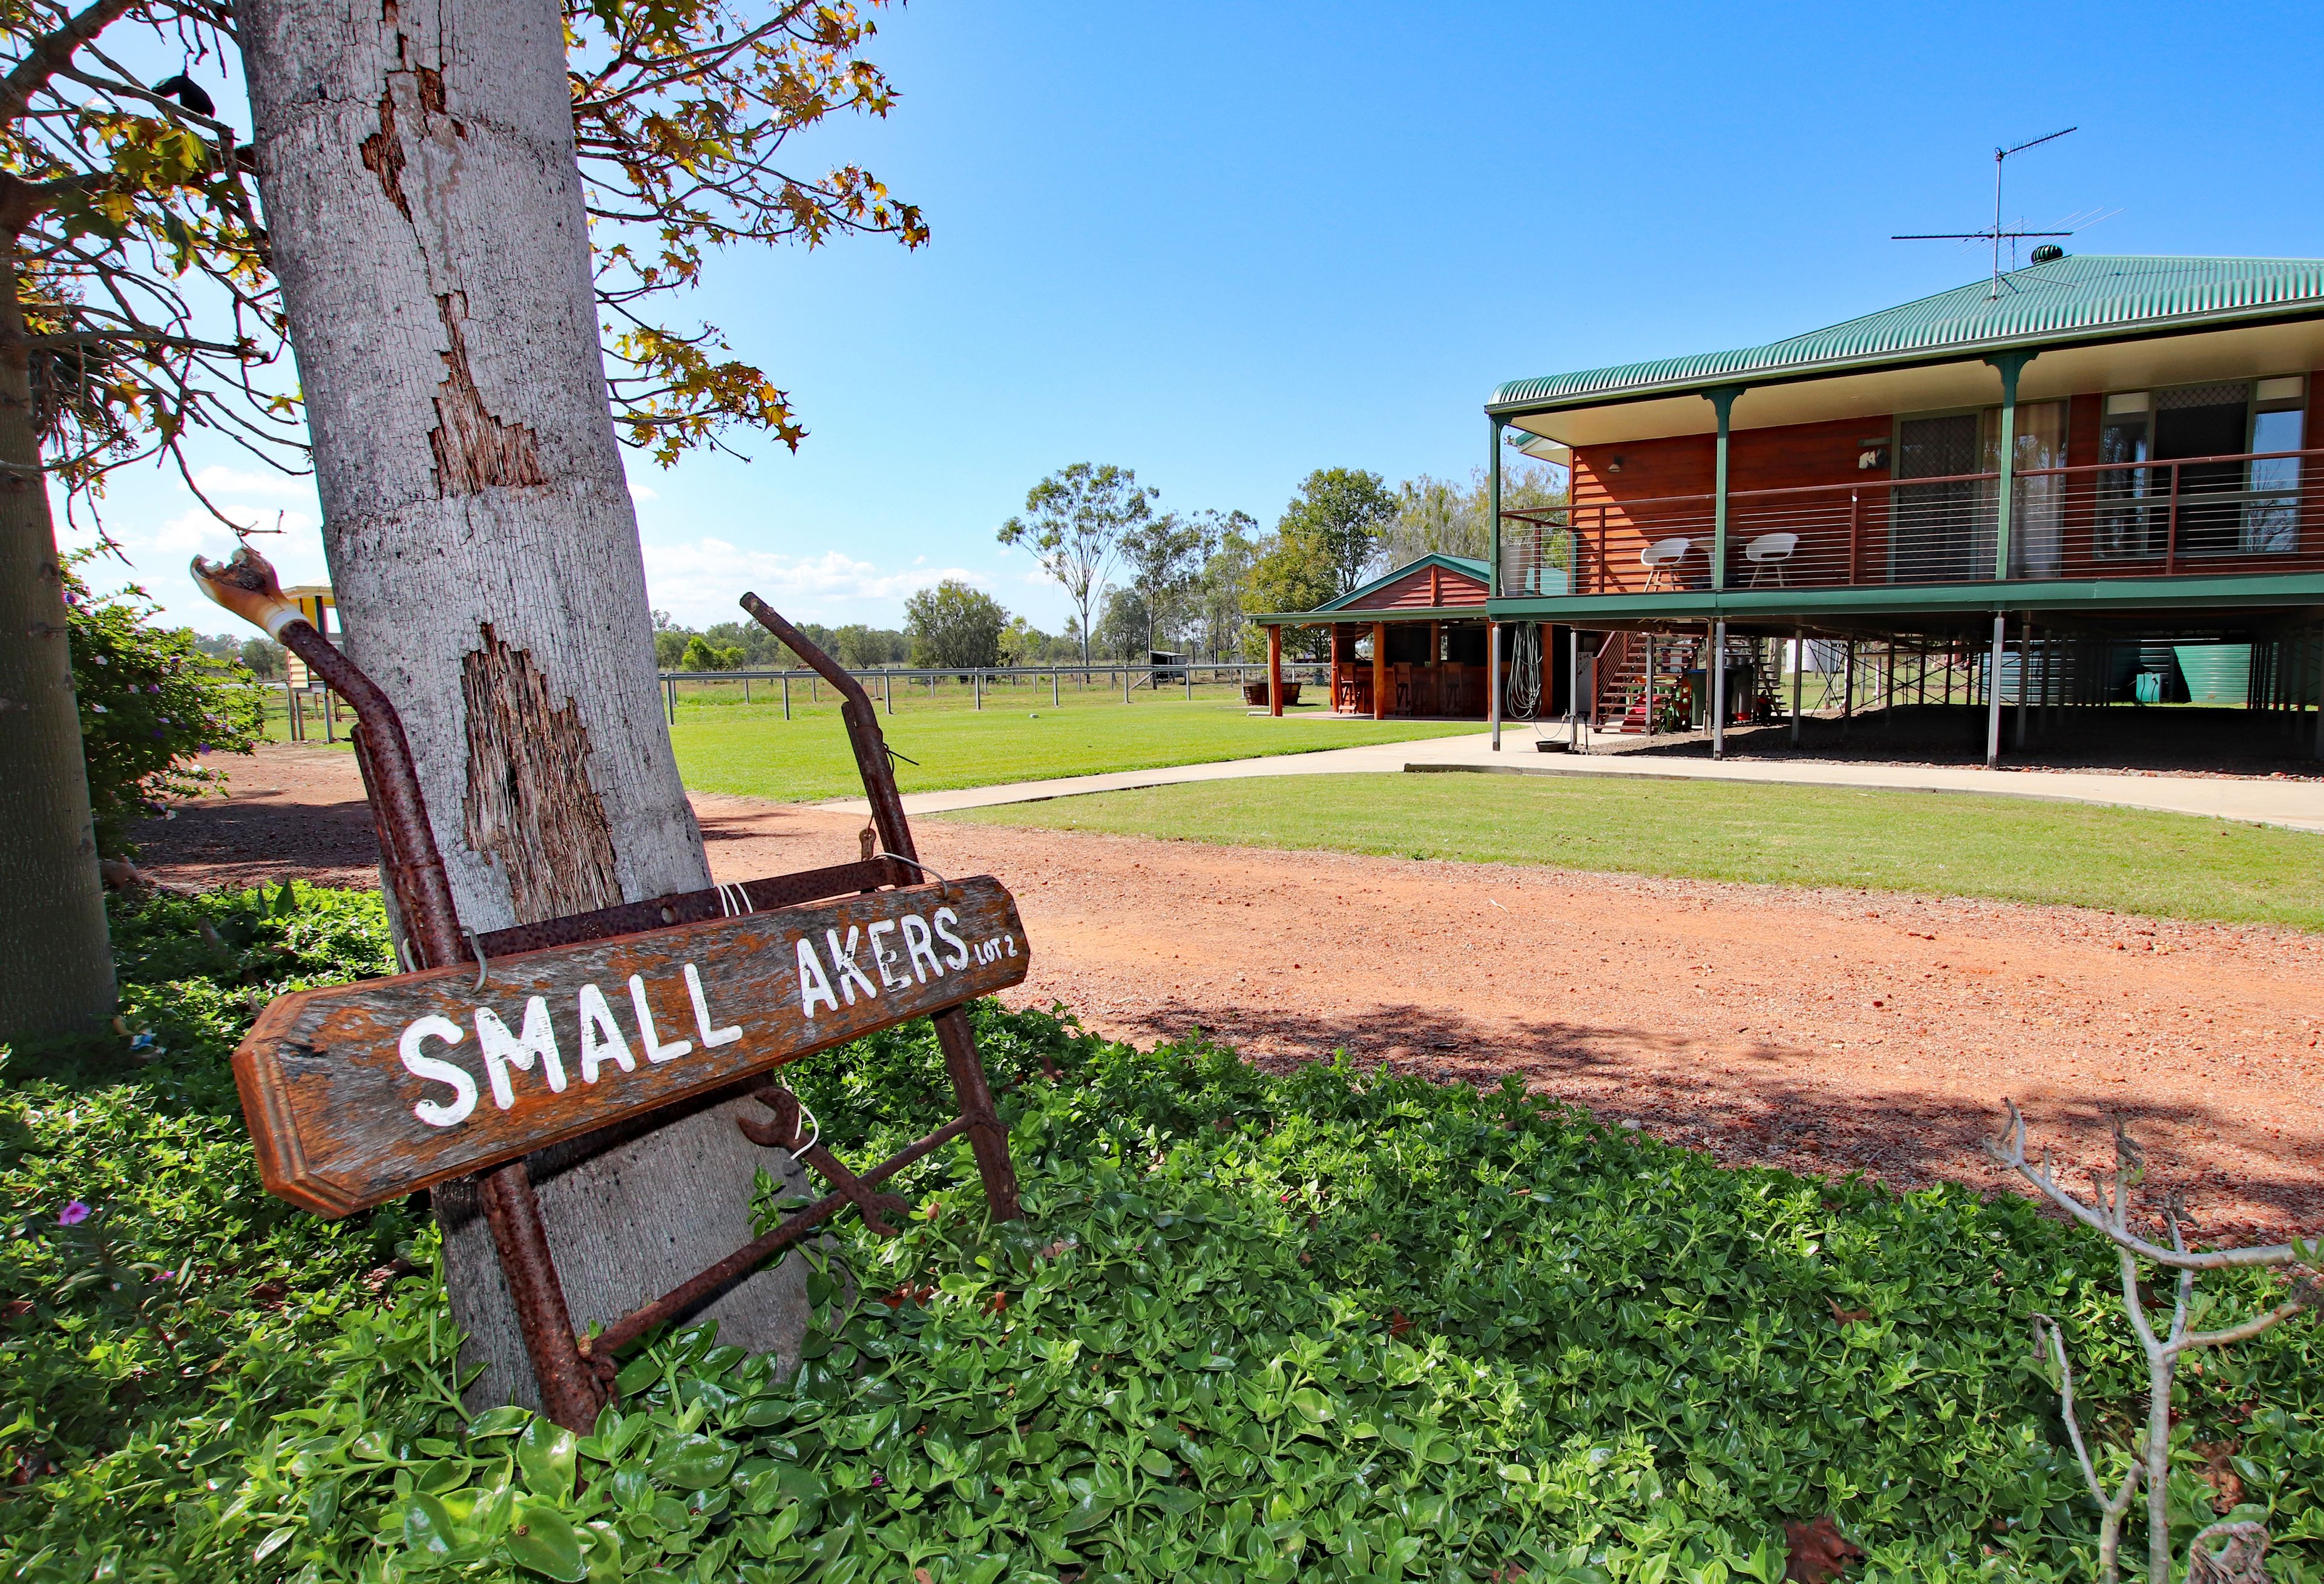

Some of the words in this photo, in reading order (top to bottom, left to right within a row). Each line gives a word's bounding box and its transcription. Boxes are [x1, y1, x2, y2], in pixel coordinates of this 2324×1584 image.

[974, 938, 1003, 965] LOT
[1004, 934, 1018, 958] 2
[399, 963, 743, 1126] SMALL
[796, 907, 969, 1019] AKERS
